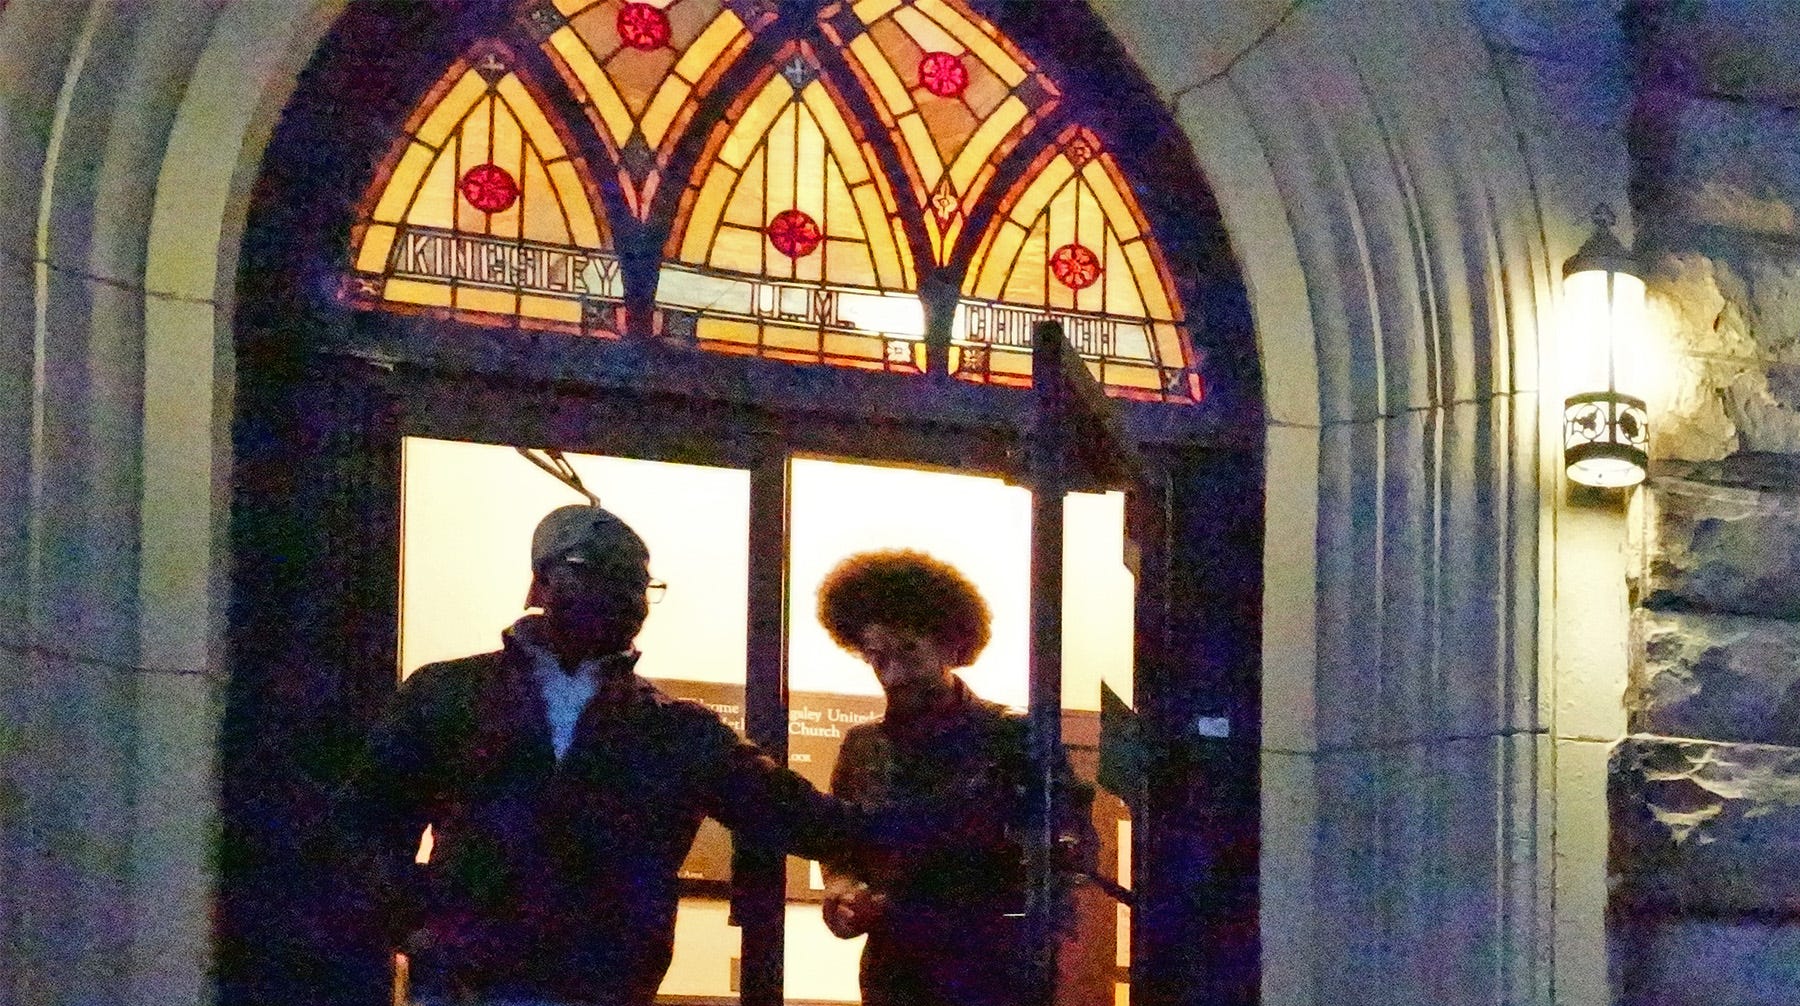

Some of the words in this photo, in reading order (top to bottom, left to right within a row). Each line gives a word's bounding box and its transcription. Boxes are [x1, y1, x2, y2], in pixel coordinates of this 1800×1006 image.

[407, 233, 619, 296] KINGSLEY
[965, 305, 1116, 357] CHUCH
[788, 721, 840, 738] Church
